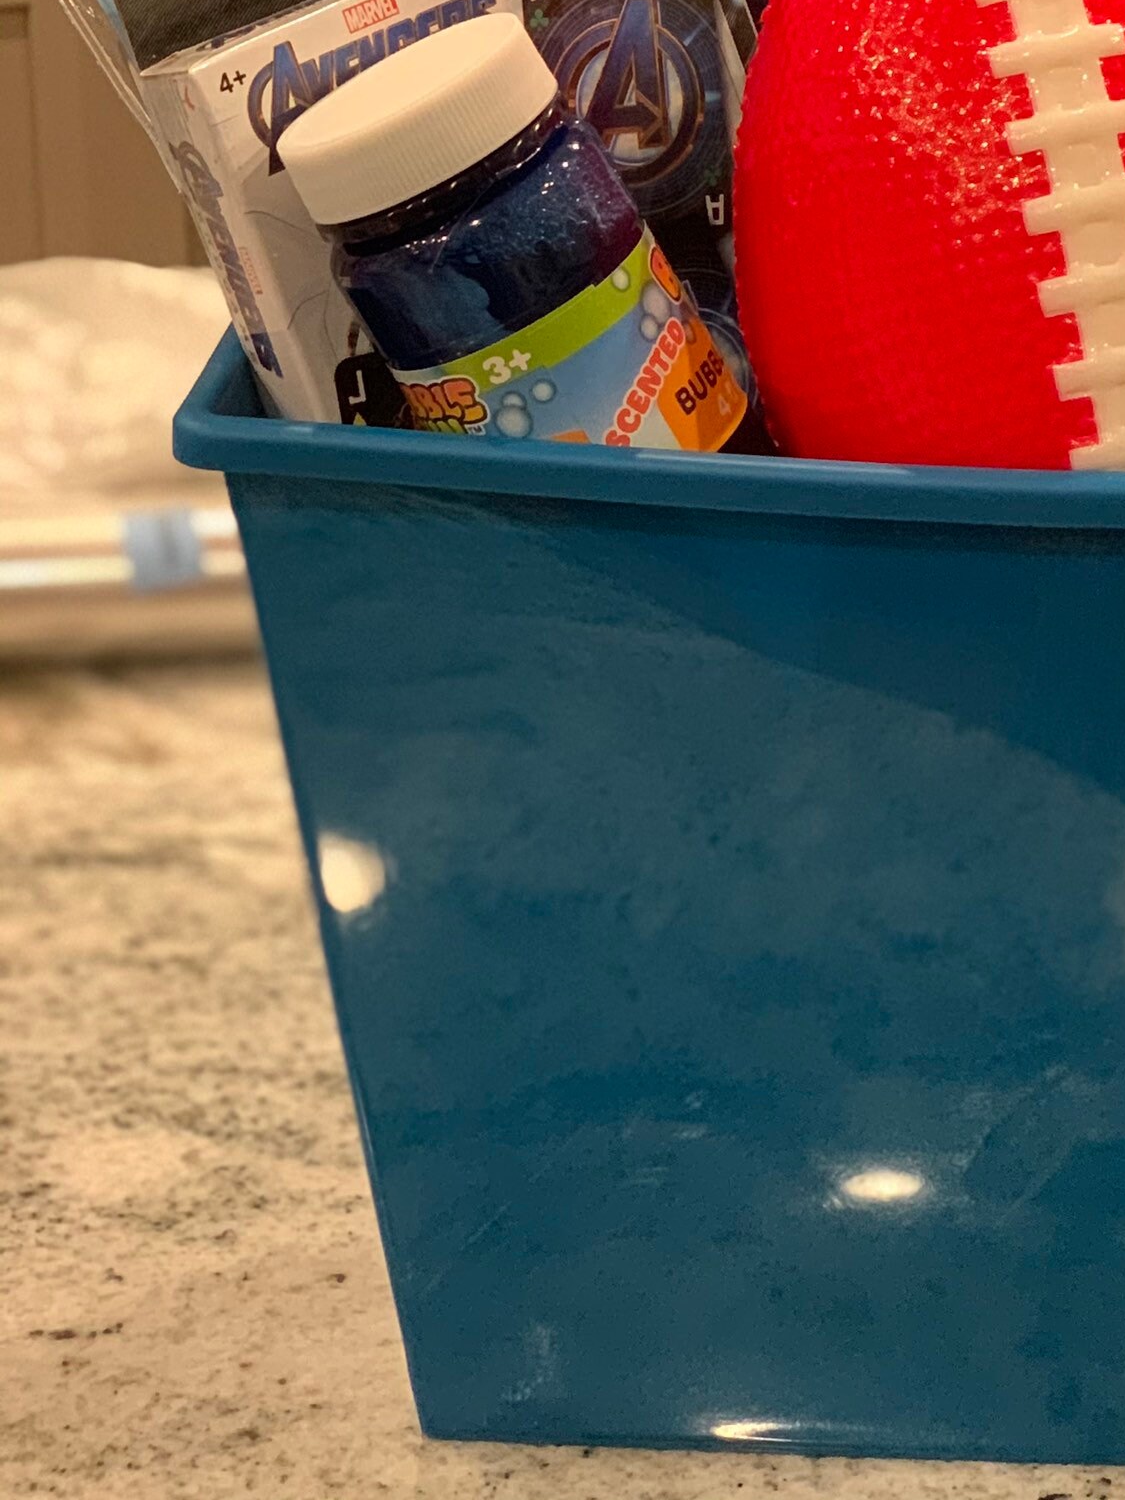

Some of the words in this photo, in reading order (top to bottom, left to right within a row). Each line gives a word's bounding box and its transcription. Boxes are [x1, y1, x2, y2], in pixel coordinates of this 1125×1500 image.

[219, 70, 247, 94] 4+
[482, 349, 531, 385] 3+
[604, 318, 685, 447] SCENTED
